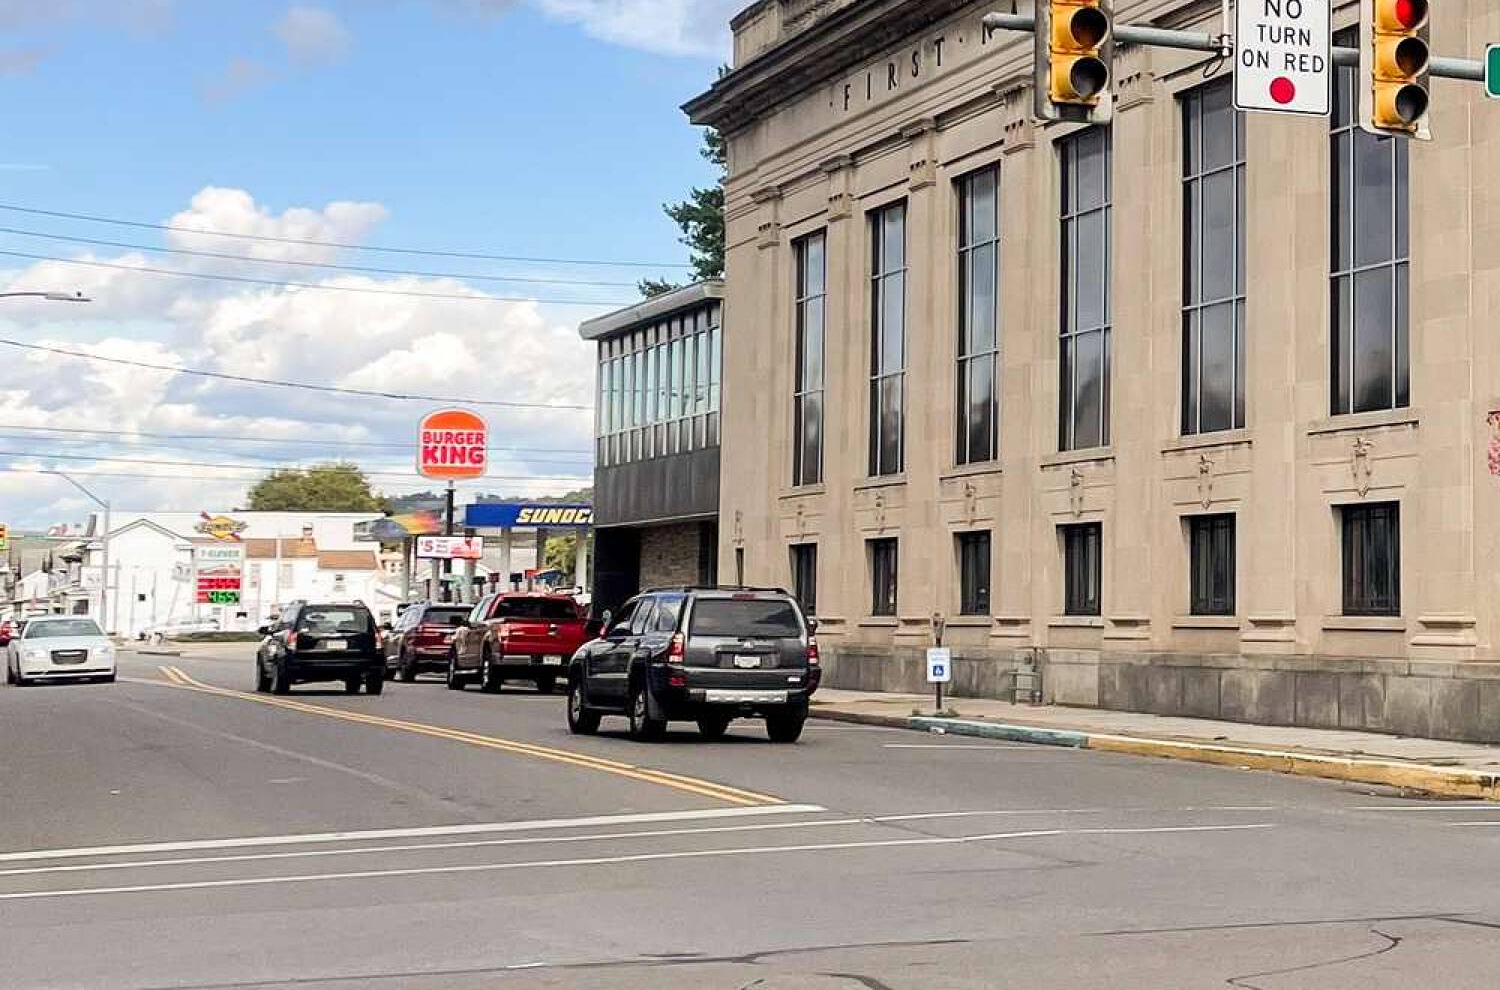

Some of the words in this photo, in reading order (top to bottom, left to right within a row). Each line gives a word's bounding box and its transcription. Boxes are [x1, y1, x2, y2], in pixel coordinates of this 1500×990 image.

[1256, 23, 1311, 46] TURN
[1242, 49, 1269, 69] ON
[1284, 52, 1324, 73] RED
[843, 37, 945, 111] FIRST
[422, 431, 485, 445] BURGER
[422, 446, 485, 465] KING
[515, 507, 594, 524] SUNOC
